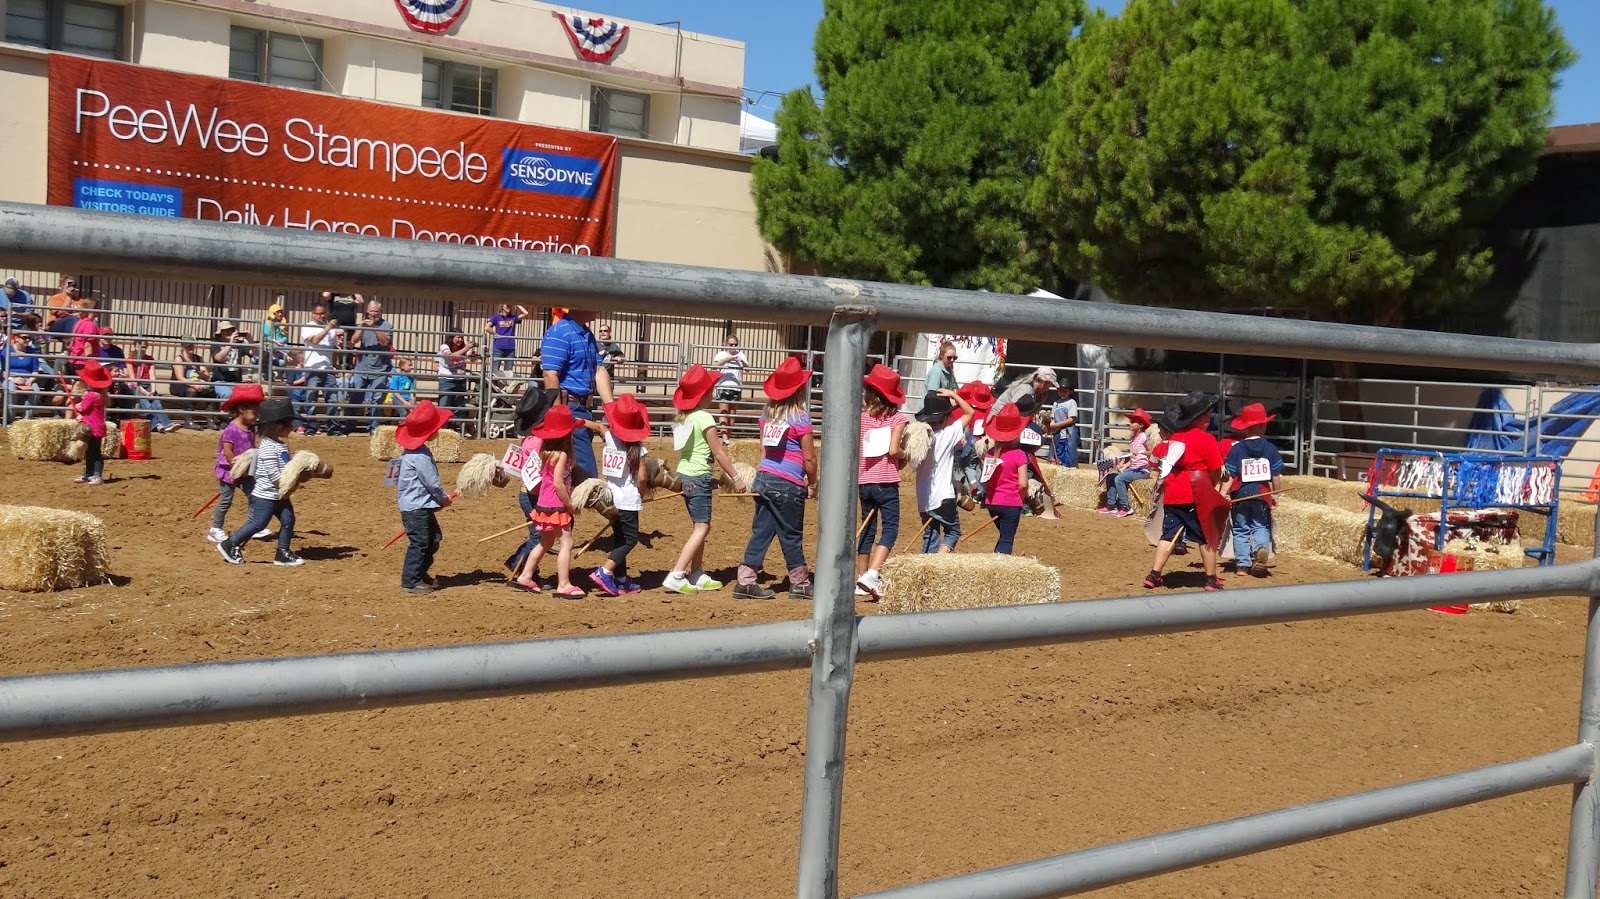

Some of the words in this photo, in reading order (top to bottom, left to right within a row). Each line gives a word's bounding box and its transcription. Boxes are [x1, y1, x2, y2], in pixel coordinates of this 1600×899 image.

[75, 88, 269, 157] PeeWee
[283, 118, 488, 183] Stampede
[535, 142, 564, 151] PRESENTED
[510, 163, 593, 186] SENSODYNE
[81, 186, 122, 198] CHECK
[125, 190, 174, 204] TODAY'S
[80, 200, 135, 213] VISITORS
[138, 205, 175, 217] GUIDE
[505, 451, 524, 470] 121
[603, 454, 624, 470] 1202
[1244, 463, 1268, 475] 1216
